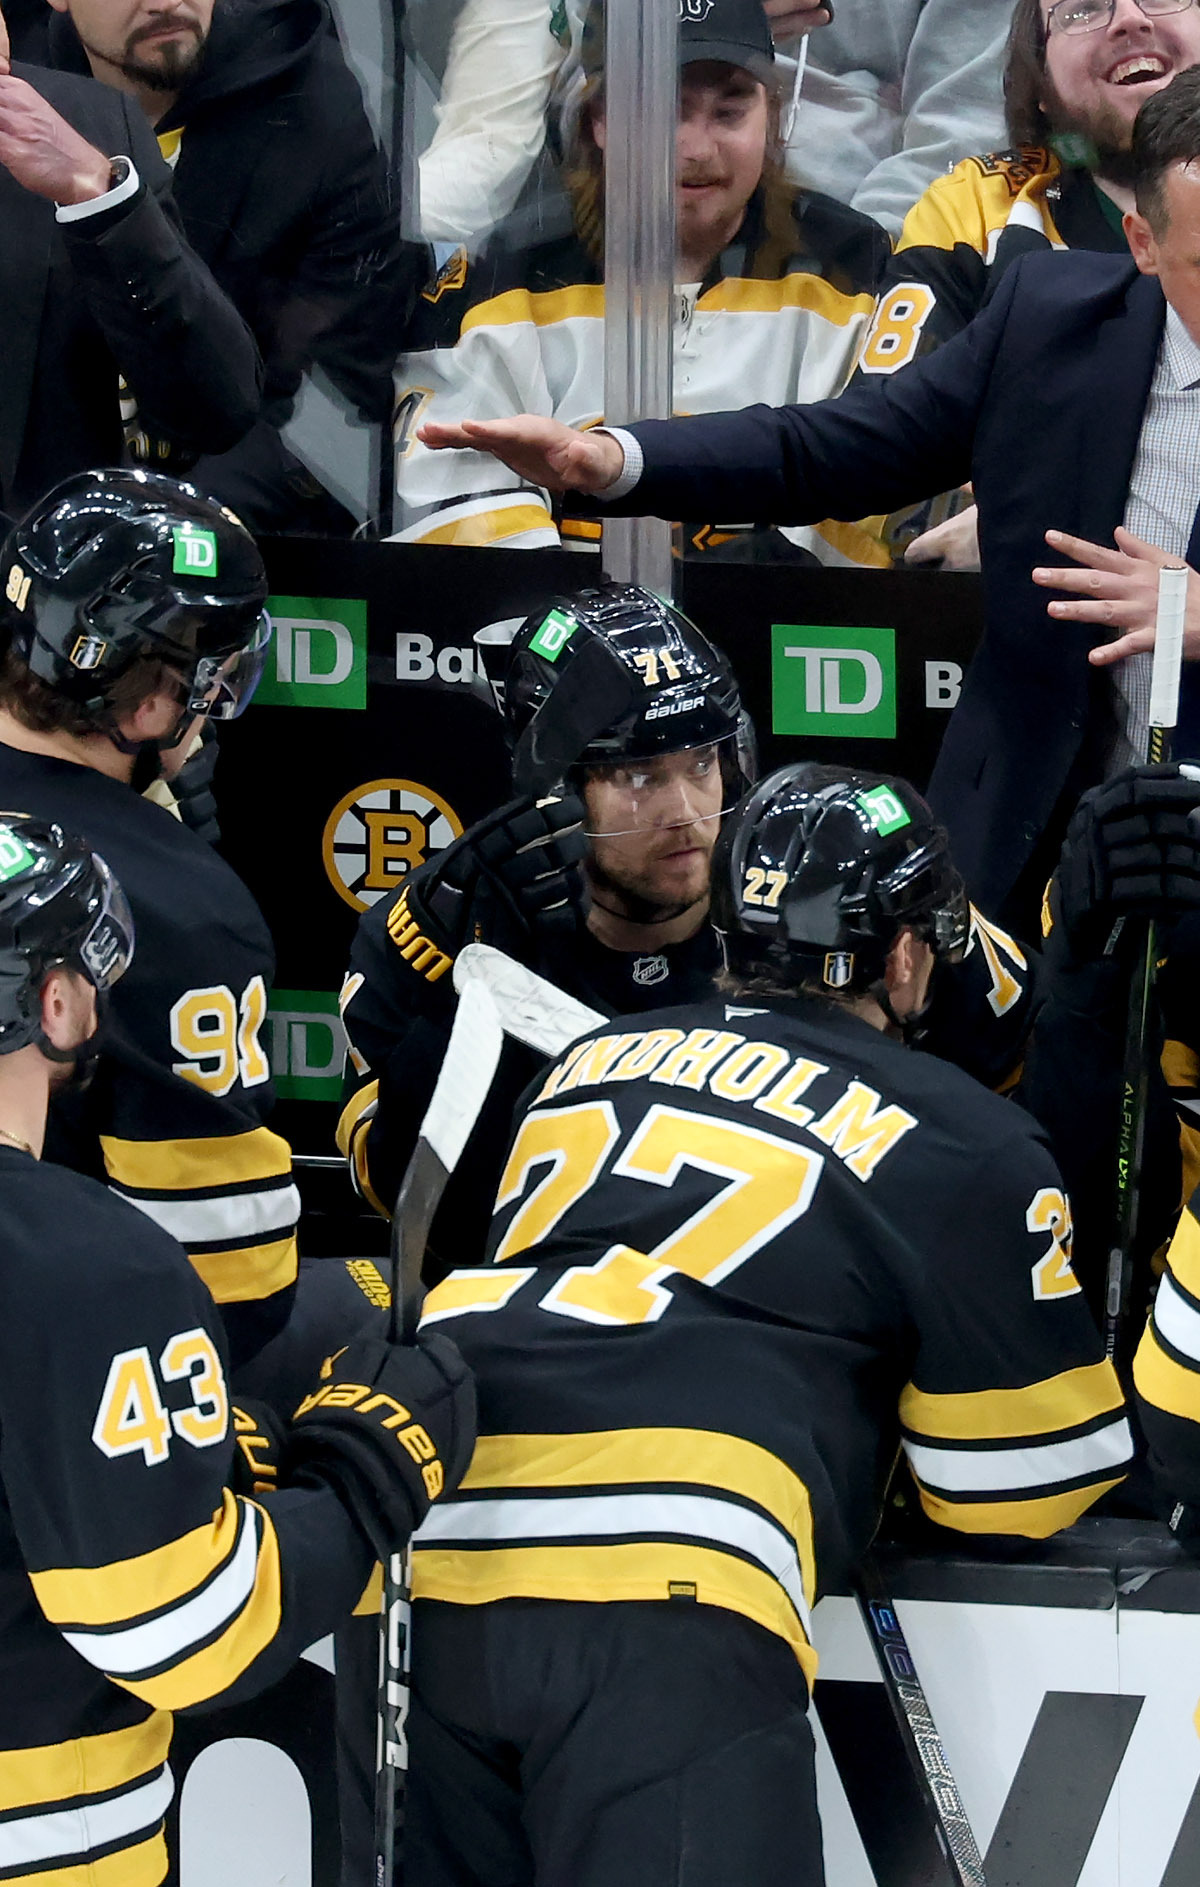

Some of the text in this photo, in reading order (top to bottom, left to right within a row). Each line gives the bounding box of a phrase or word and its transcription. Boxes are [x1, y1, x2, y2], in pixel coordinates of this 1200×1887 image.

[178, 536, 214, 567] TD
[6, 564, 32, 612] 91
[268, 617, 354, 685] TD
[538, 617, 568, 651] TD
[634, 650, 681, 687] 71
[784, 647, 883, 715] TD
[743, 866, 788, 908] 27
[170, 974, 270, 1098] 91
[267, 1010, 349, 1077] TD
[528, 1028, 919, 1183] INDHOLM
[417, 1101, 825, 1326] 27
[1026, 1187, 1083, 1301] 2
[92, 1327, 227, 1467] 43
